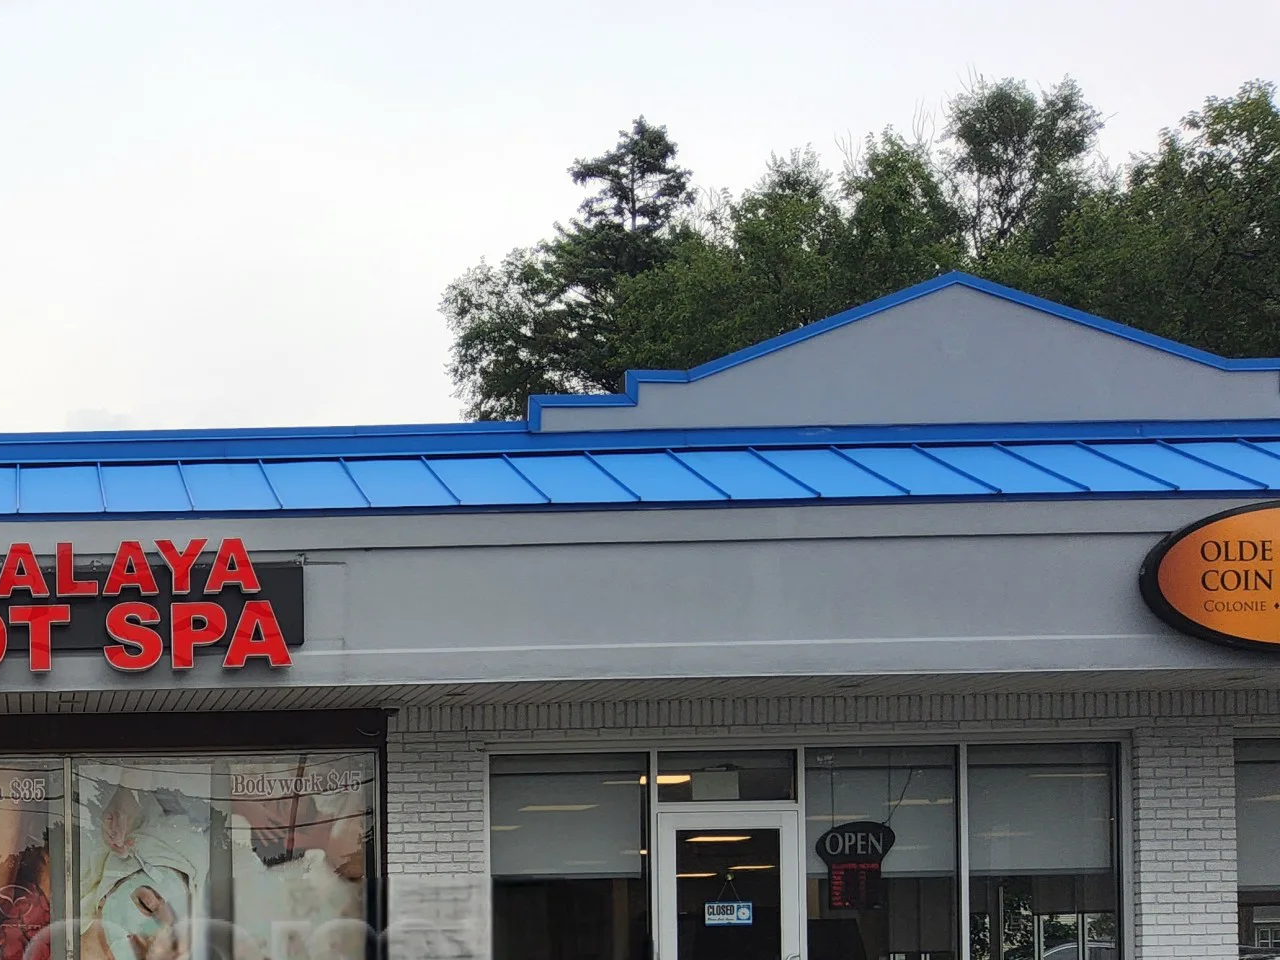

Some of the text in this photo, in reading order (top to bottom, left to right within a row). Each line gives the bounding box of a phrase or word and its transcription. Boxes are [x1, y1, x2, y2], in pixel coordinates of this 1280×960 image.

[1200, 540, 1273, 562] OLDE
[1200, 569, 1274, 592] COIN
[1203, 600, 1267, 612] COLONIE
[103, 600, 294, 673] SPA
[9, 777, 46, 804] $35
[326, 769, 362, 793] $45
[825, 832, 883, 855] OPEN
[707, 904, 735, 916] CLOSED
